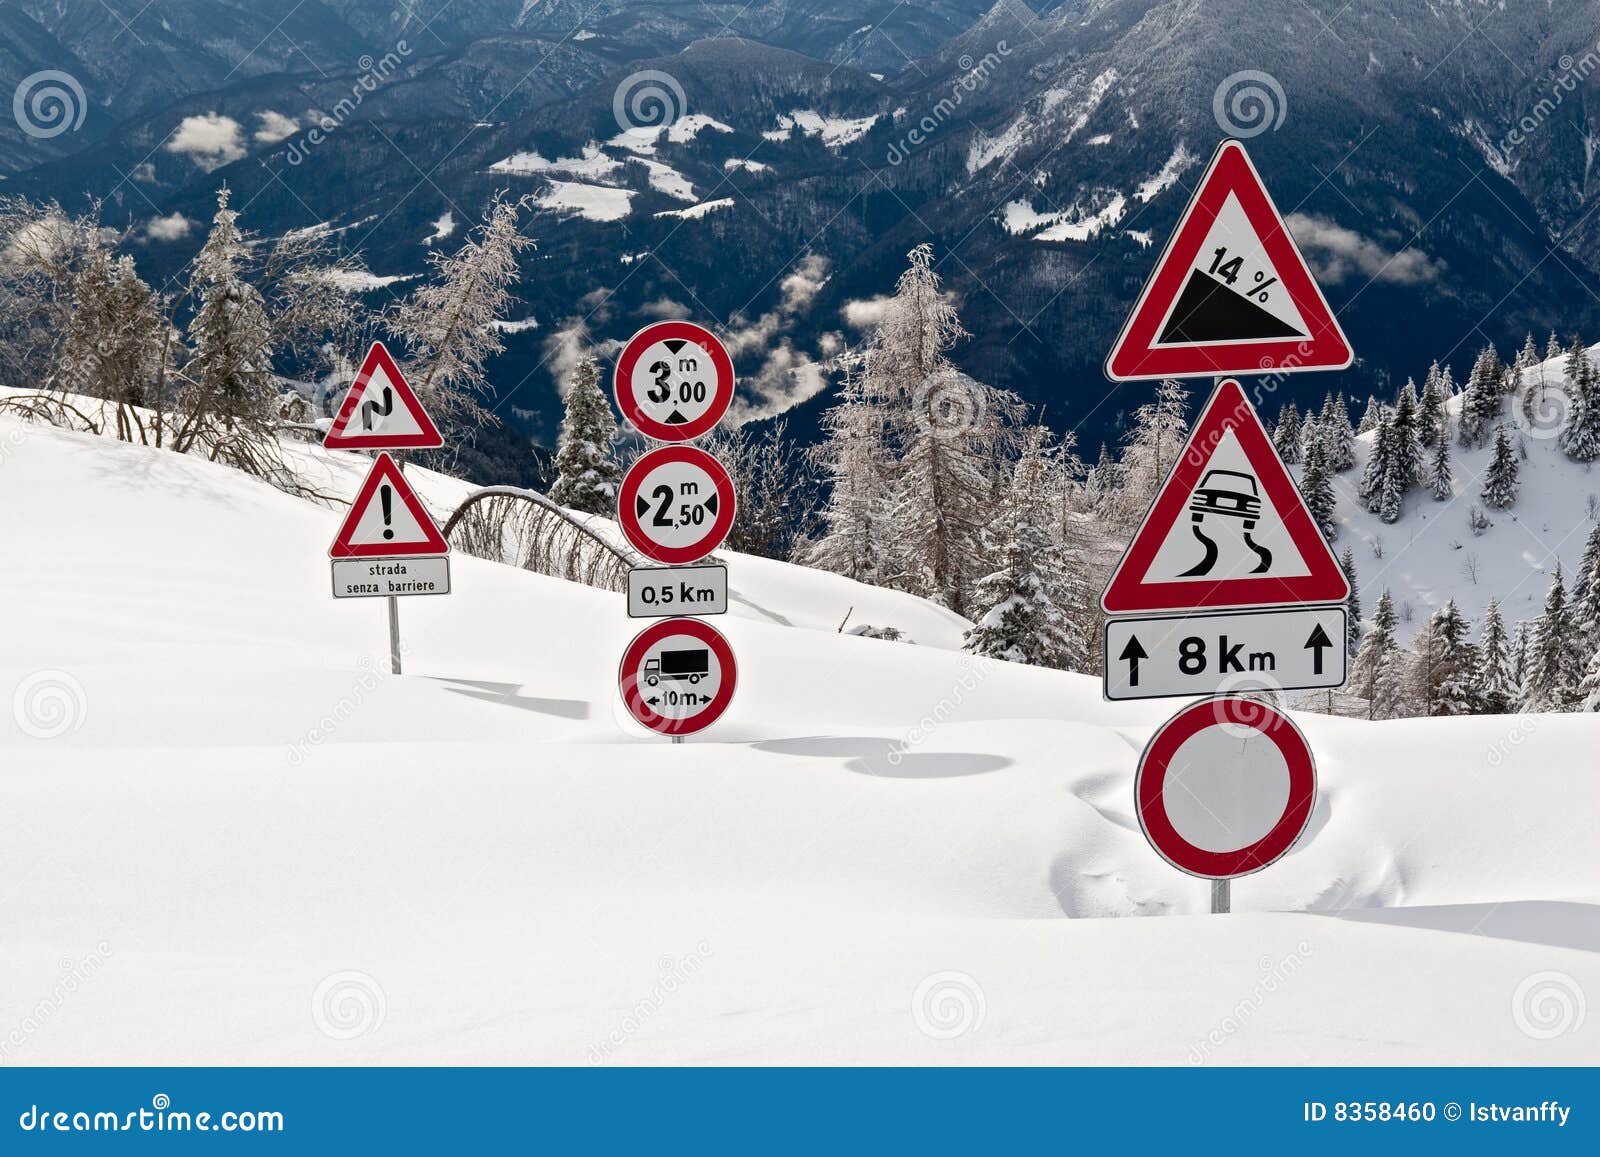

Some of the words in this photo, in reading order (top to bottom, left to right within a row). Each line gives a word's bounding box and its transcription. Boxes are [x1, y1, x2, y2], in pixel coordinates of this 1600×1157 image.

[1208, 246, 1245, 285] 14
[1246, 271, 1278, 303] %
[680, 482, 698, 495] m
[369, 563, 407, 576] strada
[346, 583, 379, 593] senza
[388, 579, 435, 592] barriere
[641, 586, 674, 606] 0,5
[680, 582, 715, 603] km
[1178, 636, 1207, 675] 8
[1218, 635, 1276, 674] km
